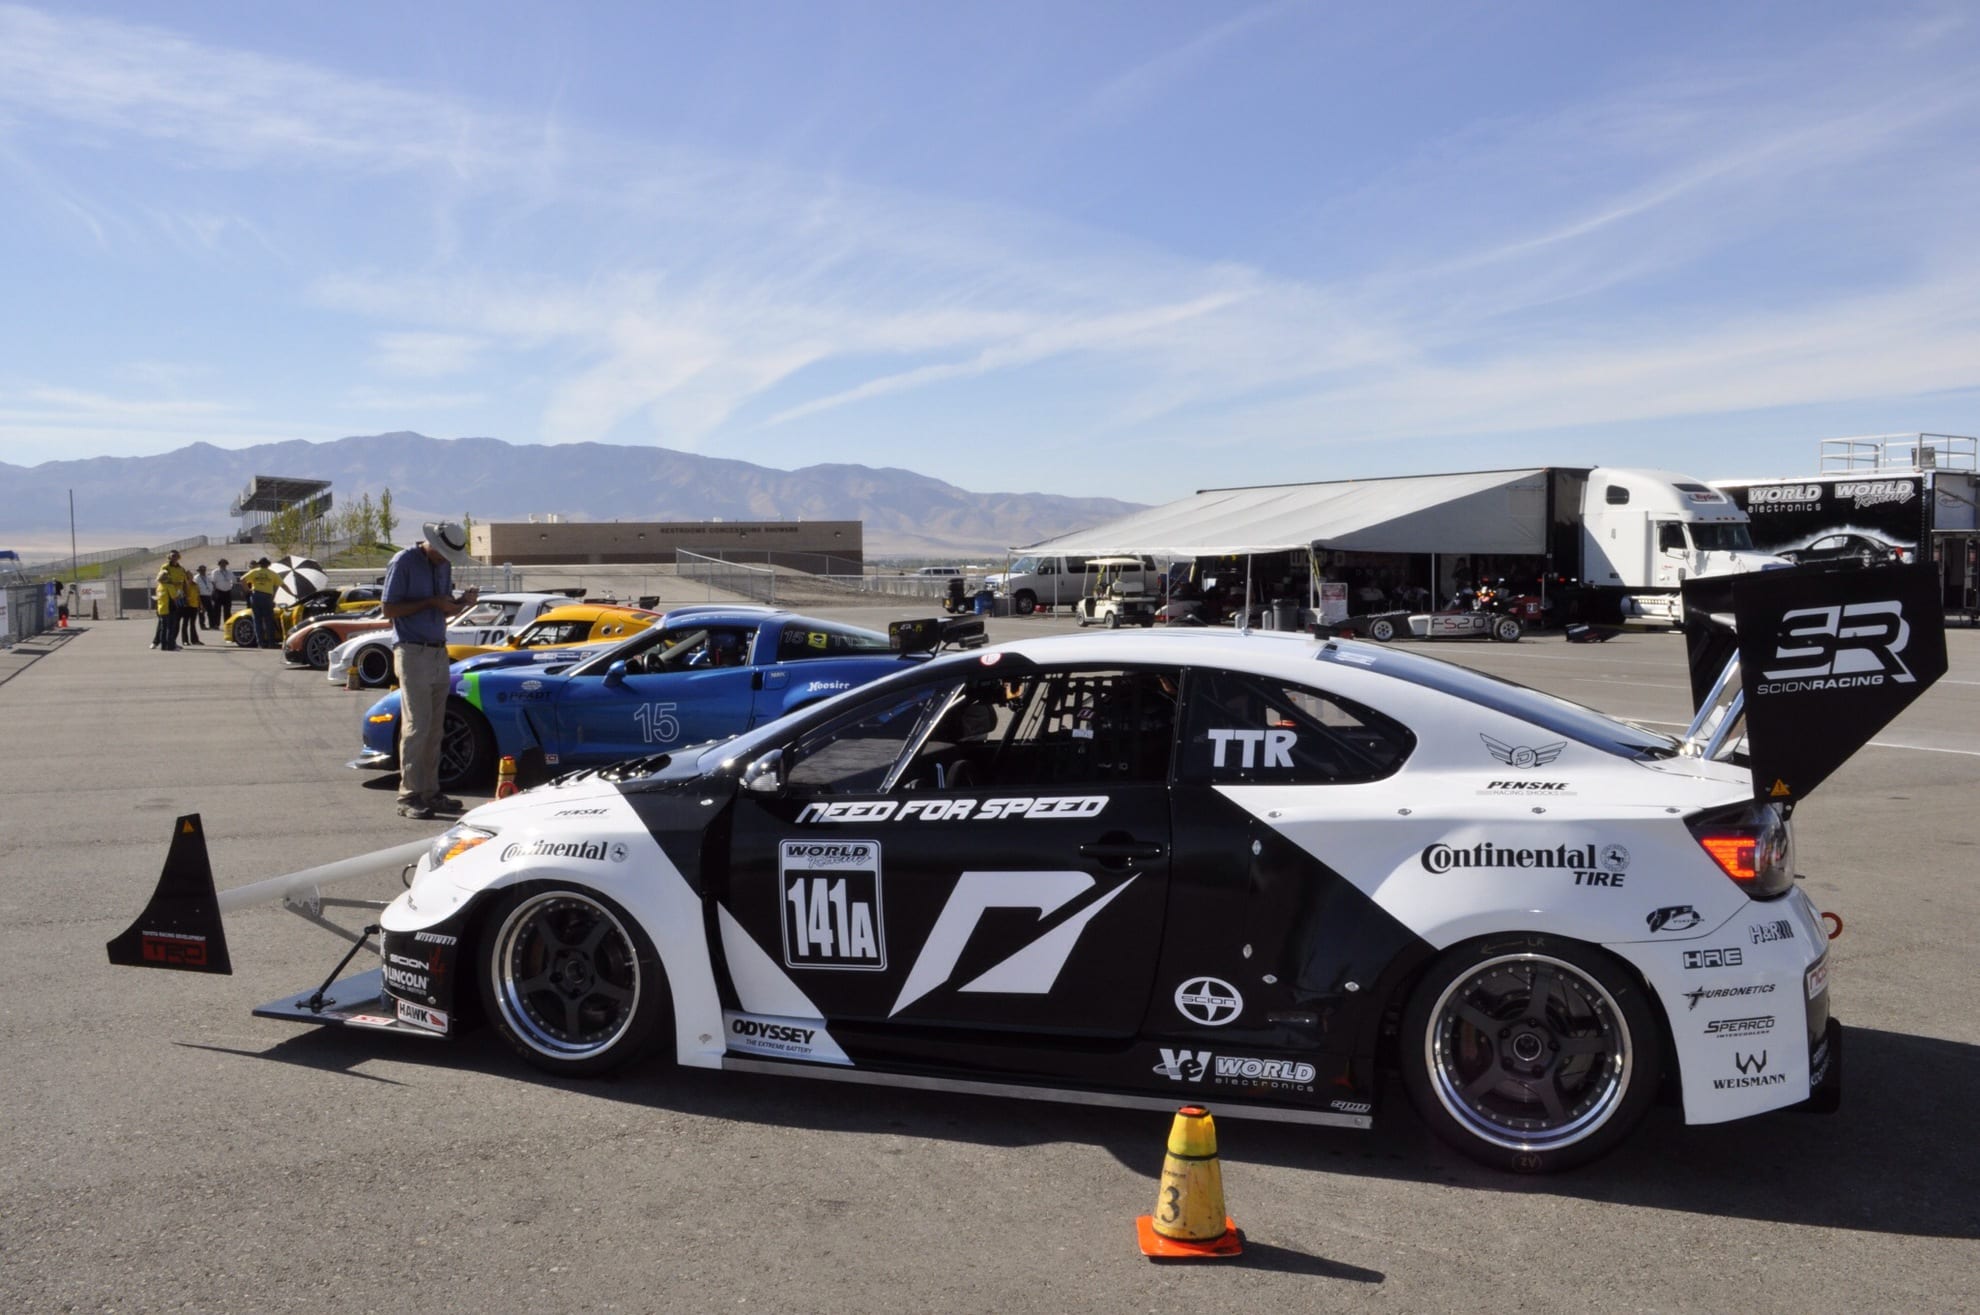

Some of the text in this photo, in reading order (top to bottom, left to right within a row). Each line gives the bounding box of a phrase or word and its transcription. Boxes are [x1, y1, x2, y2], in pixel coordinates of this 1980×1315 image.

[1748, 484, 1822, 504] WORLD
[1834, 480, 1914, 499] WORLD
[1748, 503, 1821, 513] electronics
[783, 631, 805, 643] 15
[1762, 600, 1917, 683] SR
[1757, 675, 1884, 695] SCIONRACING
[634, 702, 680, 743] 15
[1207, 729, 1298, 768] TTR
[1487, 781, 1570, 790] PENSKE
[554, 808, 609, 816] PENSKE
[794, 795, 1110, 823] NEED FOR SPEED
[786, 845, 868, 857] WORLD
[1421, 842, 1597, 874] Continental
[1574, 871, 1626, 887] TIRE
[787, 878, 878, 958] 141A
[389, 953, 430, 971] SCION
[1683, 948, 1743, 969] HRE
[388, 966, 427, 990] LINCOLN
[1181, 995, 1236, 1006] SCION
[1682, 984, 1776, 1011] TURBONETICS
[400, 1003, 428, 1023] HAWK
[732, 1019, 816, 1045] ODYSSEY
[1704, 1015, 1775, 1034] SPEARCO
[758, 1041, 785, 1050] EXTREME
[786, 1045, 813, 1054] BATTERY
[1215, 1056, 1316, 1083] WORLD
[1215, 1077, 1314, 1092] electronics
[1713, 1073, 1786, 1090] WEISMANN
[1161, 1186, 1180, 1223] 3
